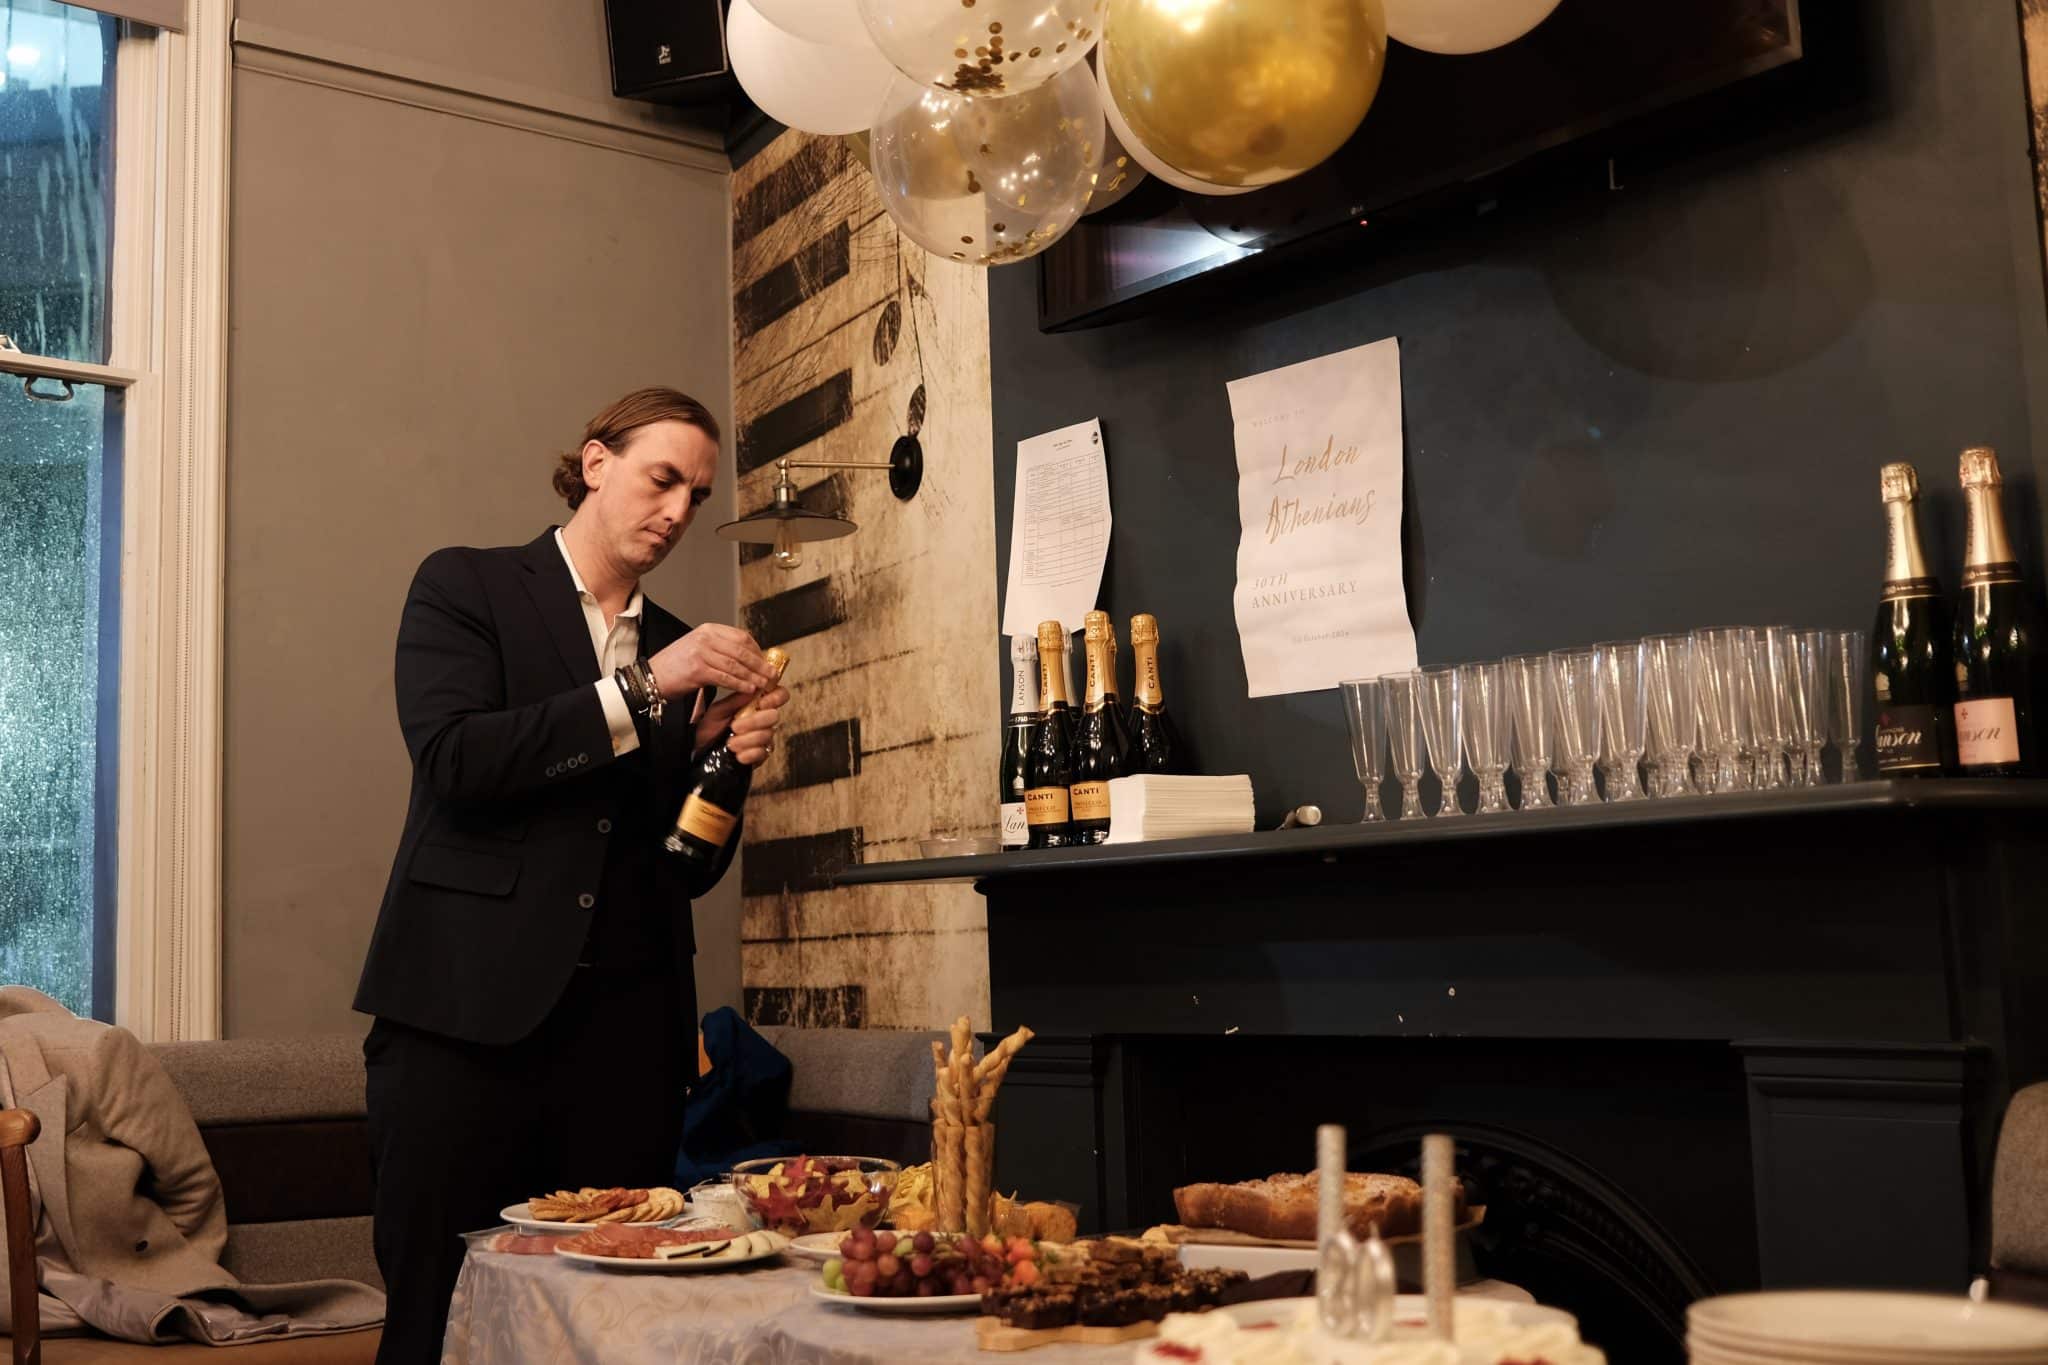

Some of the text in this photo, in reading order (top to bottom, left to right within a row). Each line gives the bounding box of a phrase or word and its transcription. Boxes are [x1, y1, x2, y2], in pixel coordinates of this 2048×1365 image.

[1272, 434, 1361, 485] London
[1265, 489, 1376, 544] Athenians
[1251, 579, 1359, 609] ANNIVERSARY
[1016, 670, 1025, 706] LANSON
[1147, 656, 1156, 689] CANTI
[1027, 793, 1054, 802] CANTI
[1073, 786, 1100, 796] CANTI
